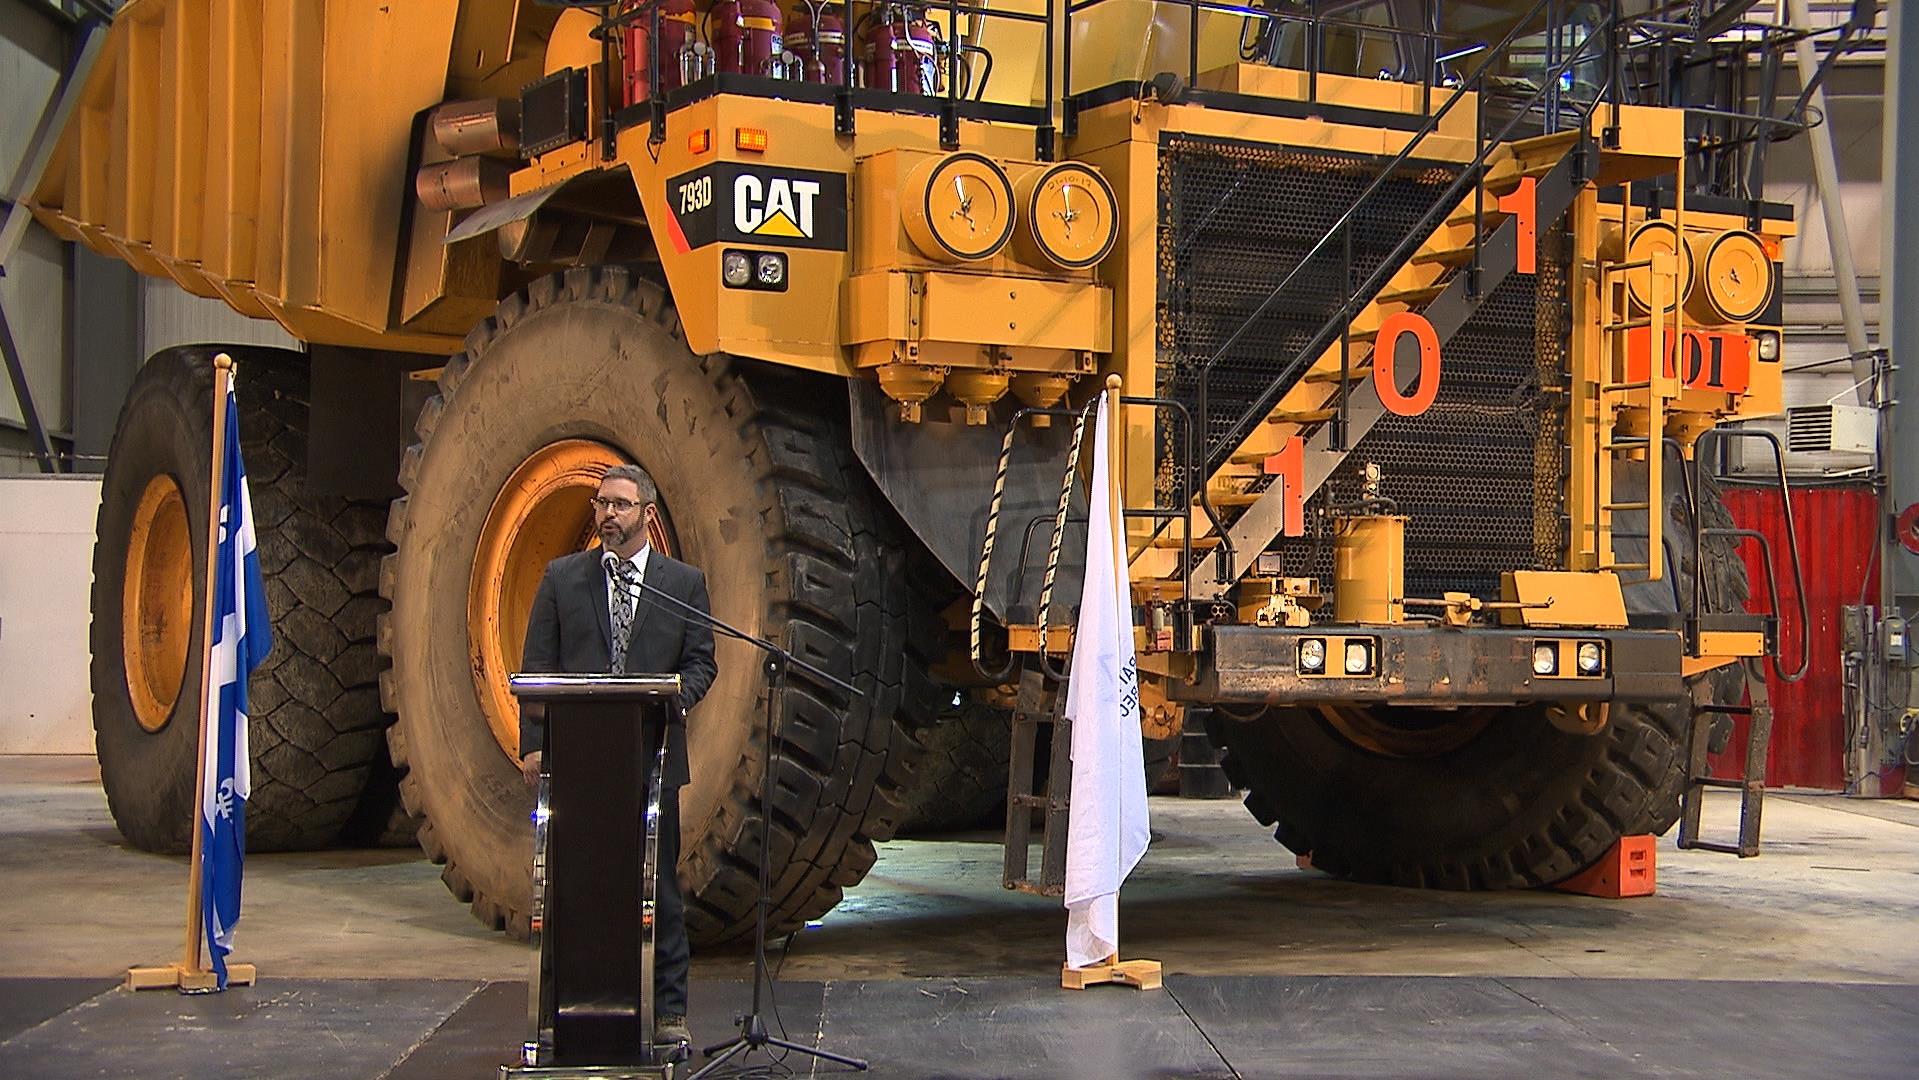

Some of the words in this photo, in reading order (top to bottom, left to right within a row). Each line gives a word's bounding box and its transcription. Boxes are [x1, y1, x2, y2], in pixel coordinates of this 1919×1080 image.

[679, 176, 712, 215] 793D
[734, 174, 820, 239] CAT
[1663, 330, 1724, 387] 01
